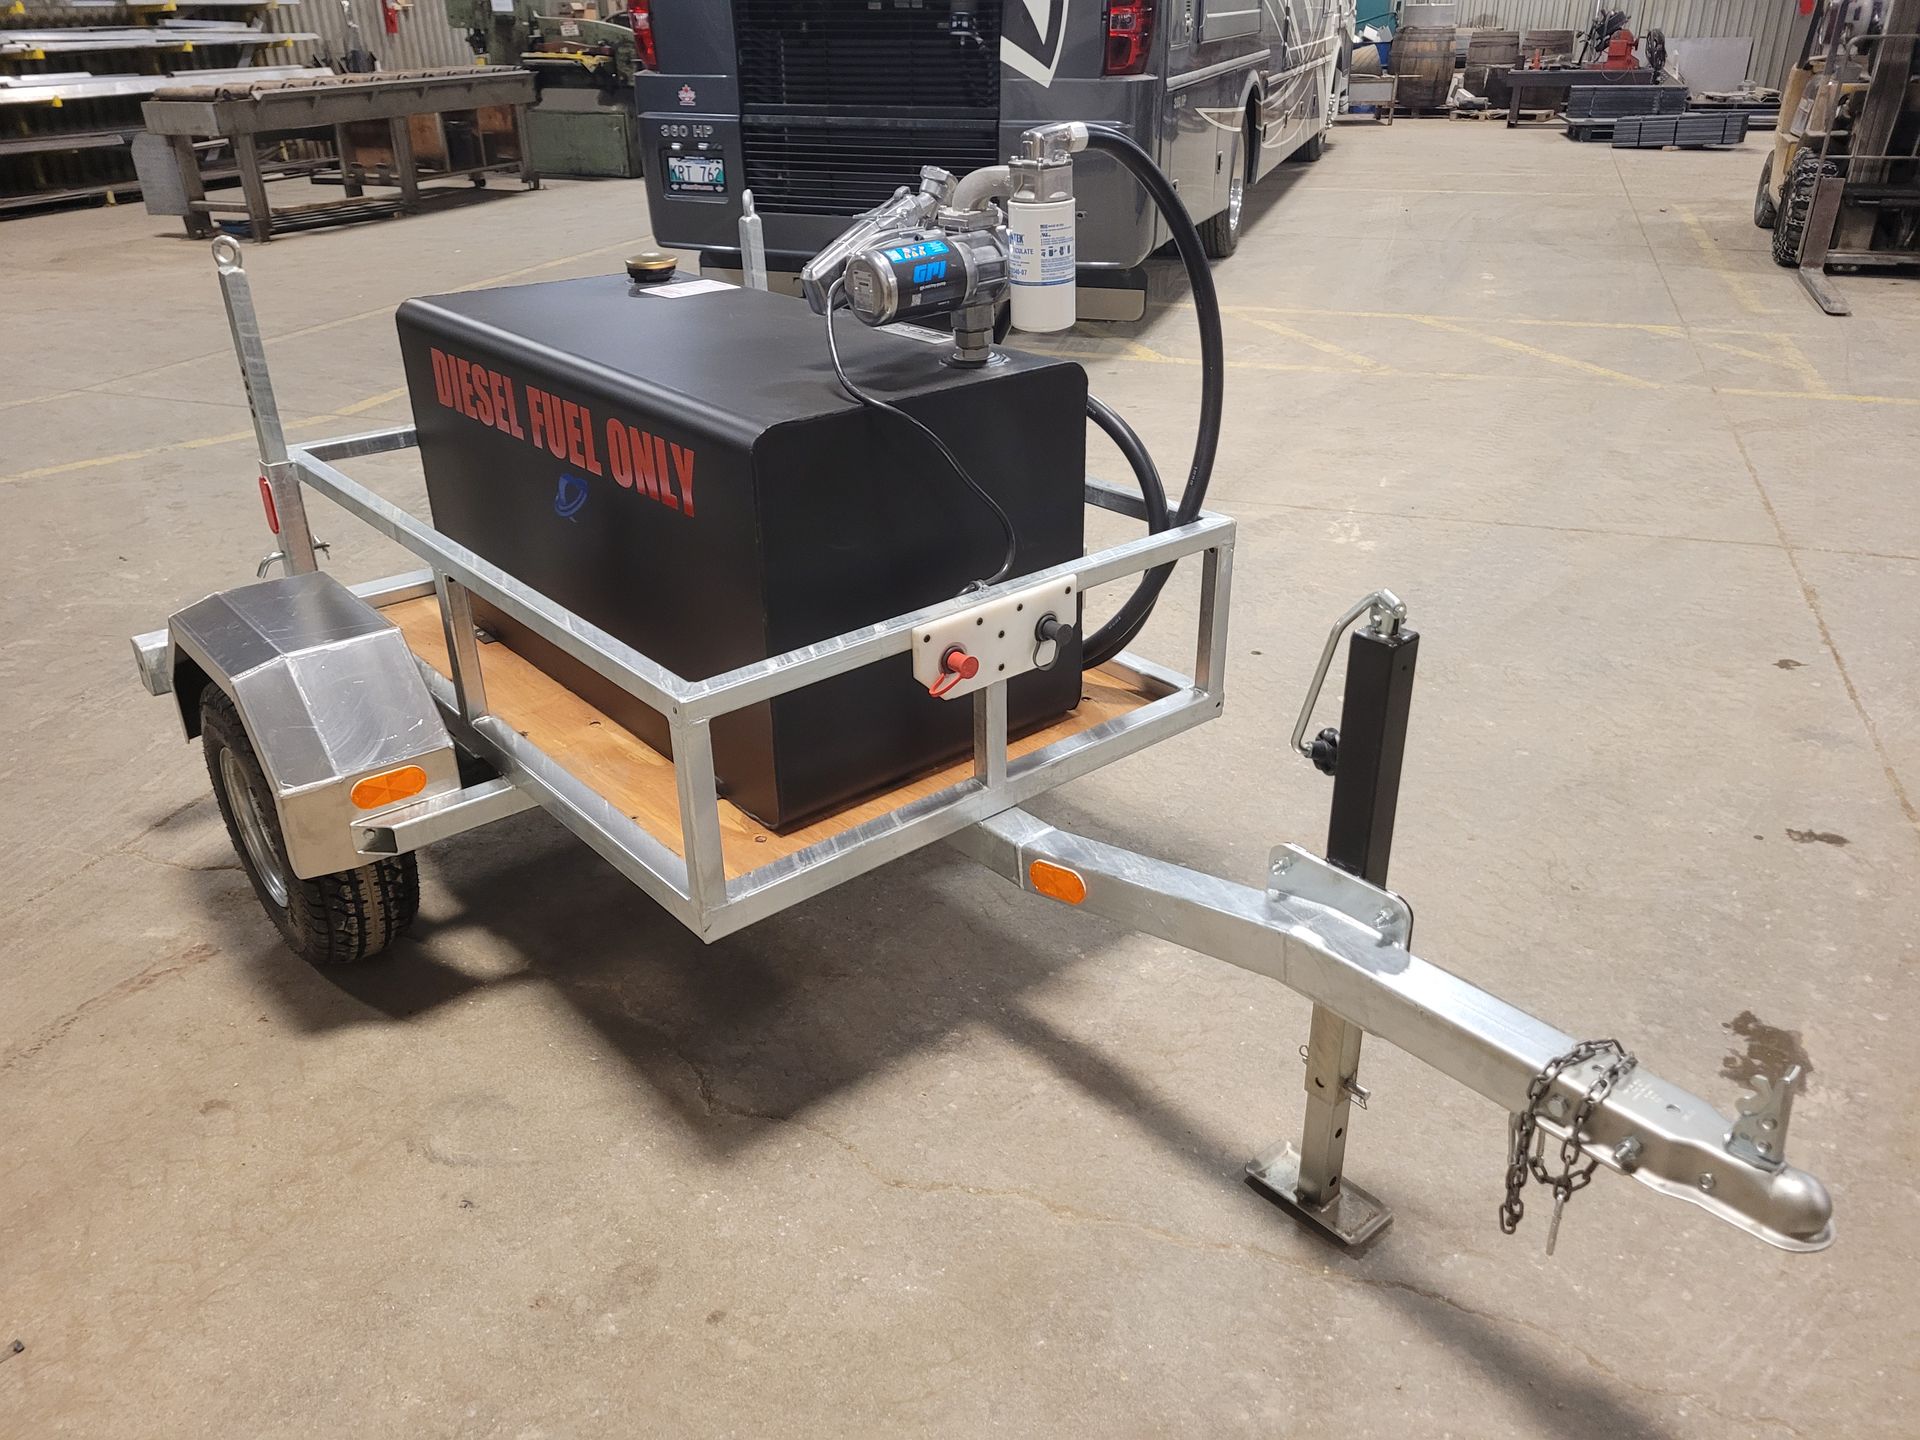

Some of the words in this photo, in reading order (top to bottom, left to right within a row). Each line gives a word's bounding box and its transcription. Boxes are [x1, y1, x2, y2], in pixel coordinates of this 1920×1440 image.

[692, 124, 714, 138] HP
[670, 164, 692, 182] KRT
[700, 166, 723, 182] 762
[913, 260, 947, 284] GPI
[430, 347, 525, 441] DIESEL
[526, 384, 602, 477] FUEL
[606, 417, 695, 518] ONLY
